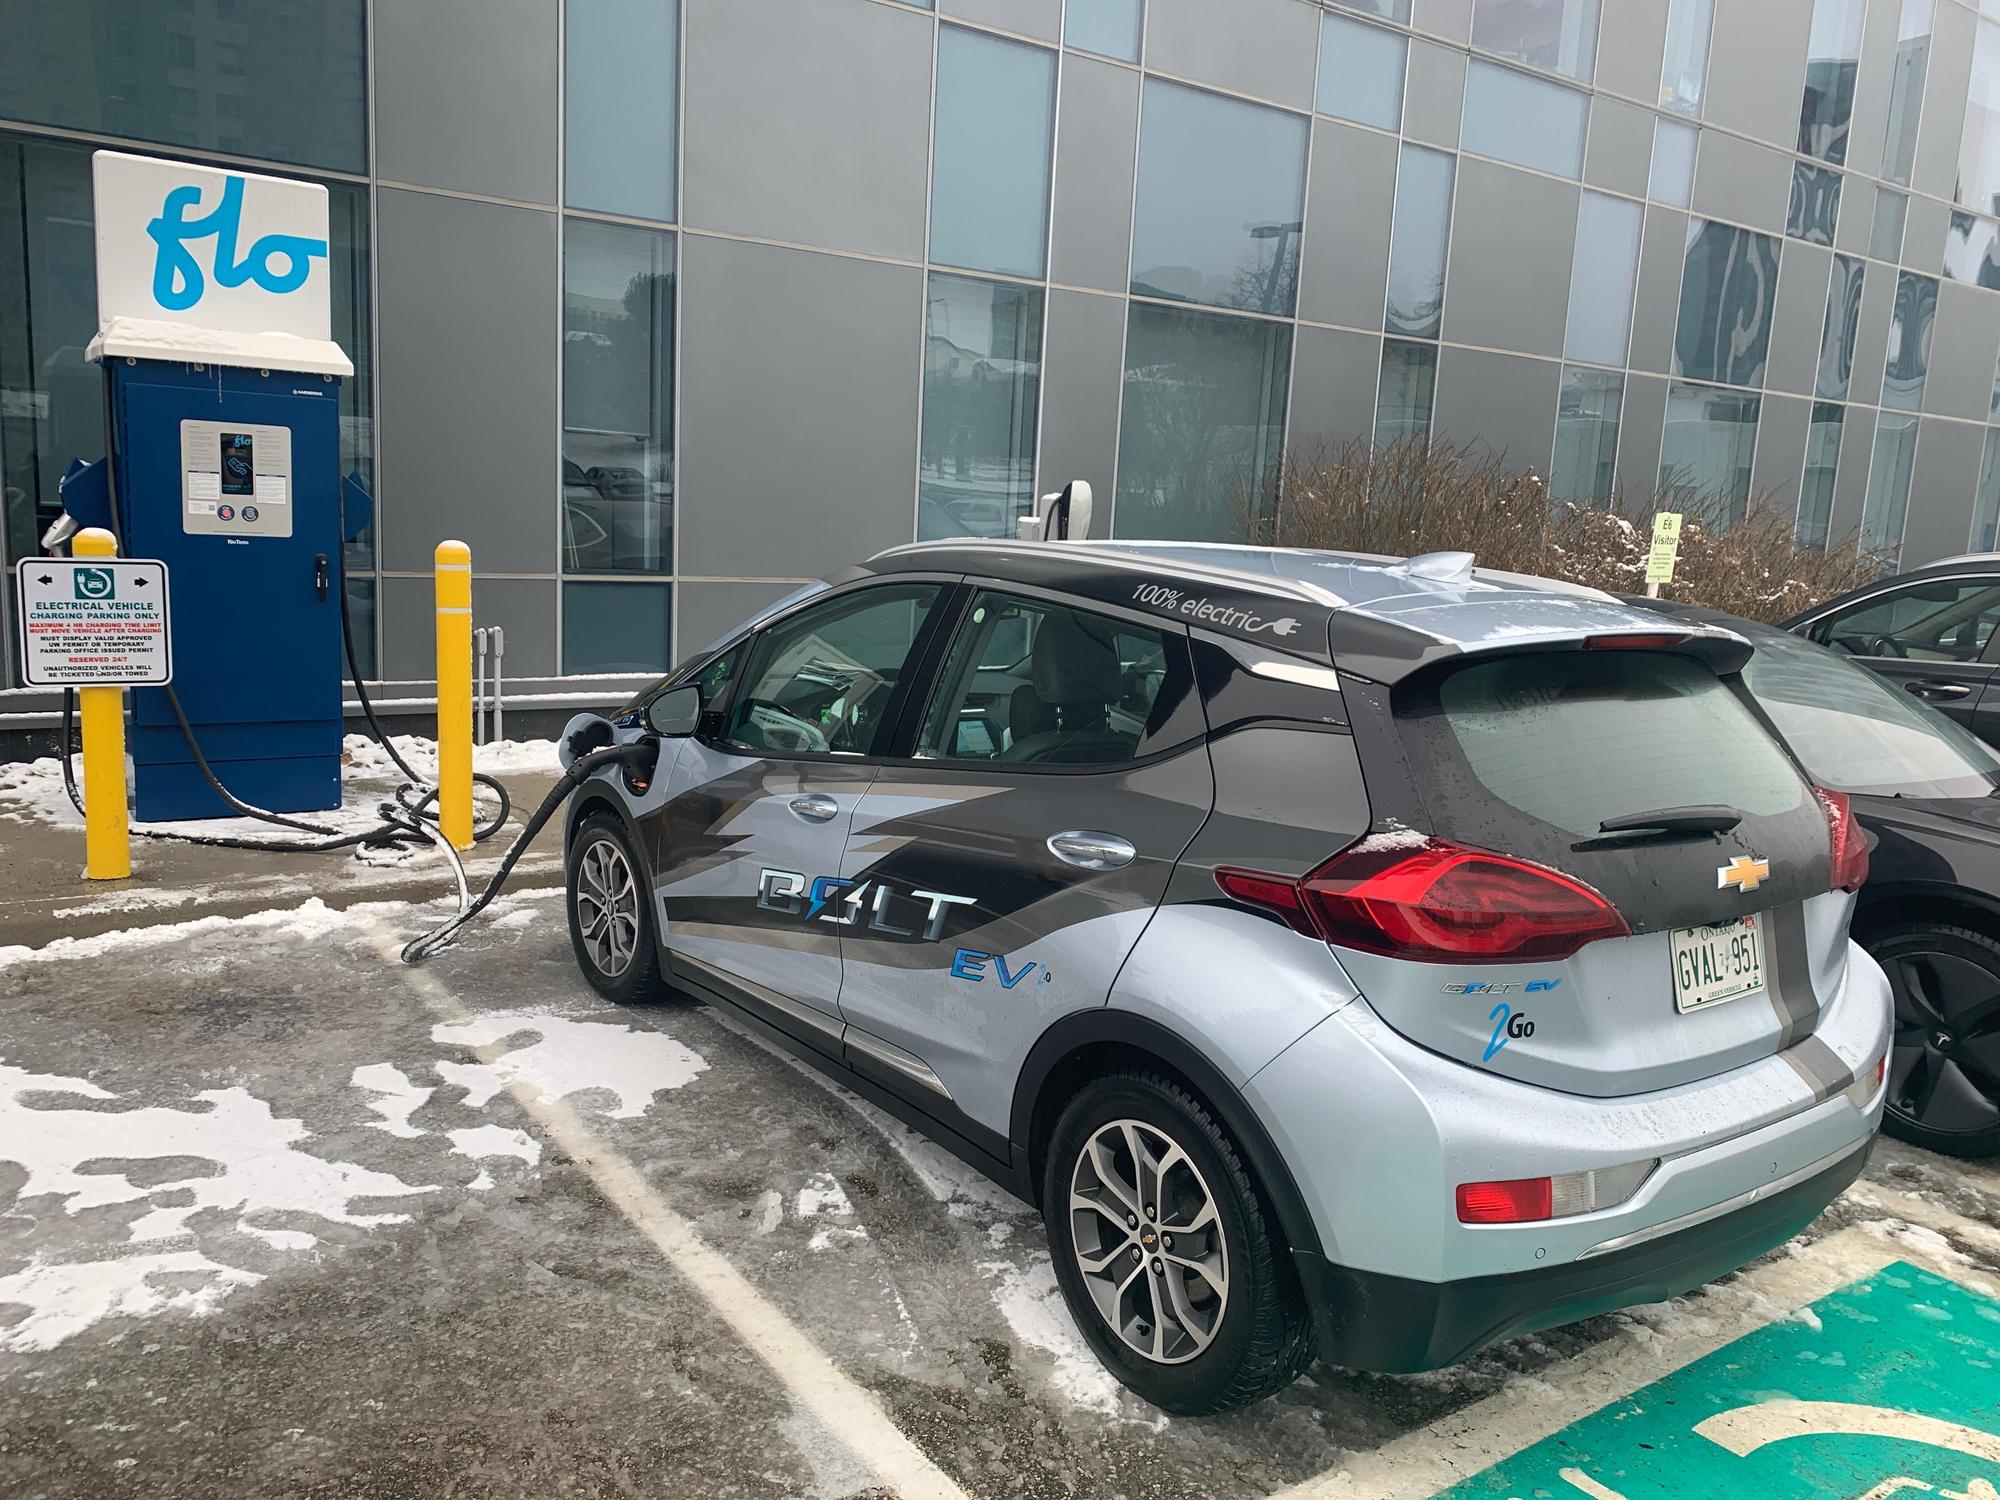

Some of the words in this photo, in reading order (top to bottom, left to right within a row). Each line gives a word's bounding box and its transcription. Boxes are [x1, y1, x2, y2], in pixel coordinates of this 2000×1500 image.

[146, 175, 328, 312] flo
[1662, 519, 1673, 530] E6
[1653, 534, 1678, 545] Visitor
[30, 612, 83, 620] CHARGING
[87, 612, 131, 620] PARKING
[134, 612, 160, 620] ONLY
[35, 601, 104, 610] ELECTRICAL
[107, 602, 154, 611] VEHICLE
[1131, 583, 1184, 610] 100%
[1180, 598, 1262, 633] electric
[756, 867, 978, 943] BOLT
[951, 947, 1037, 989] EV
[1679, 942, 1723, 991] GVAL
[1731, 931, 1760, 975] 951
[1525, 978, 1563, 992] EV
